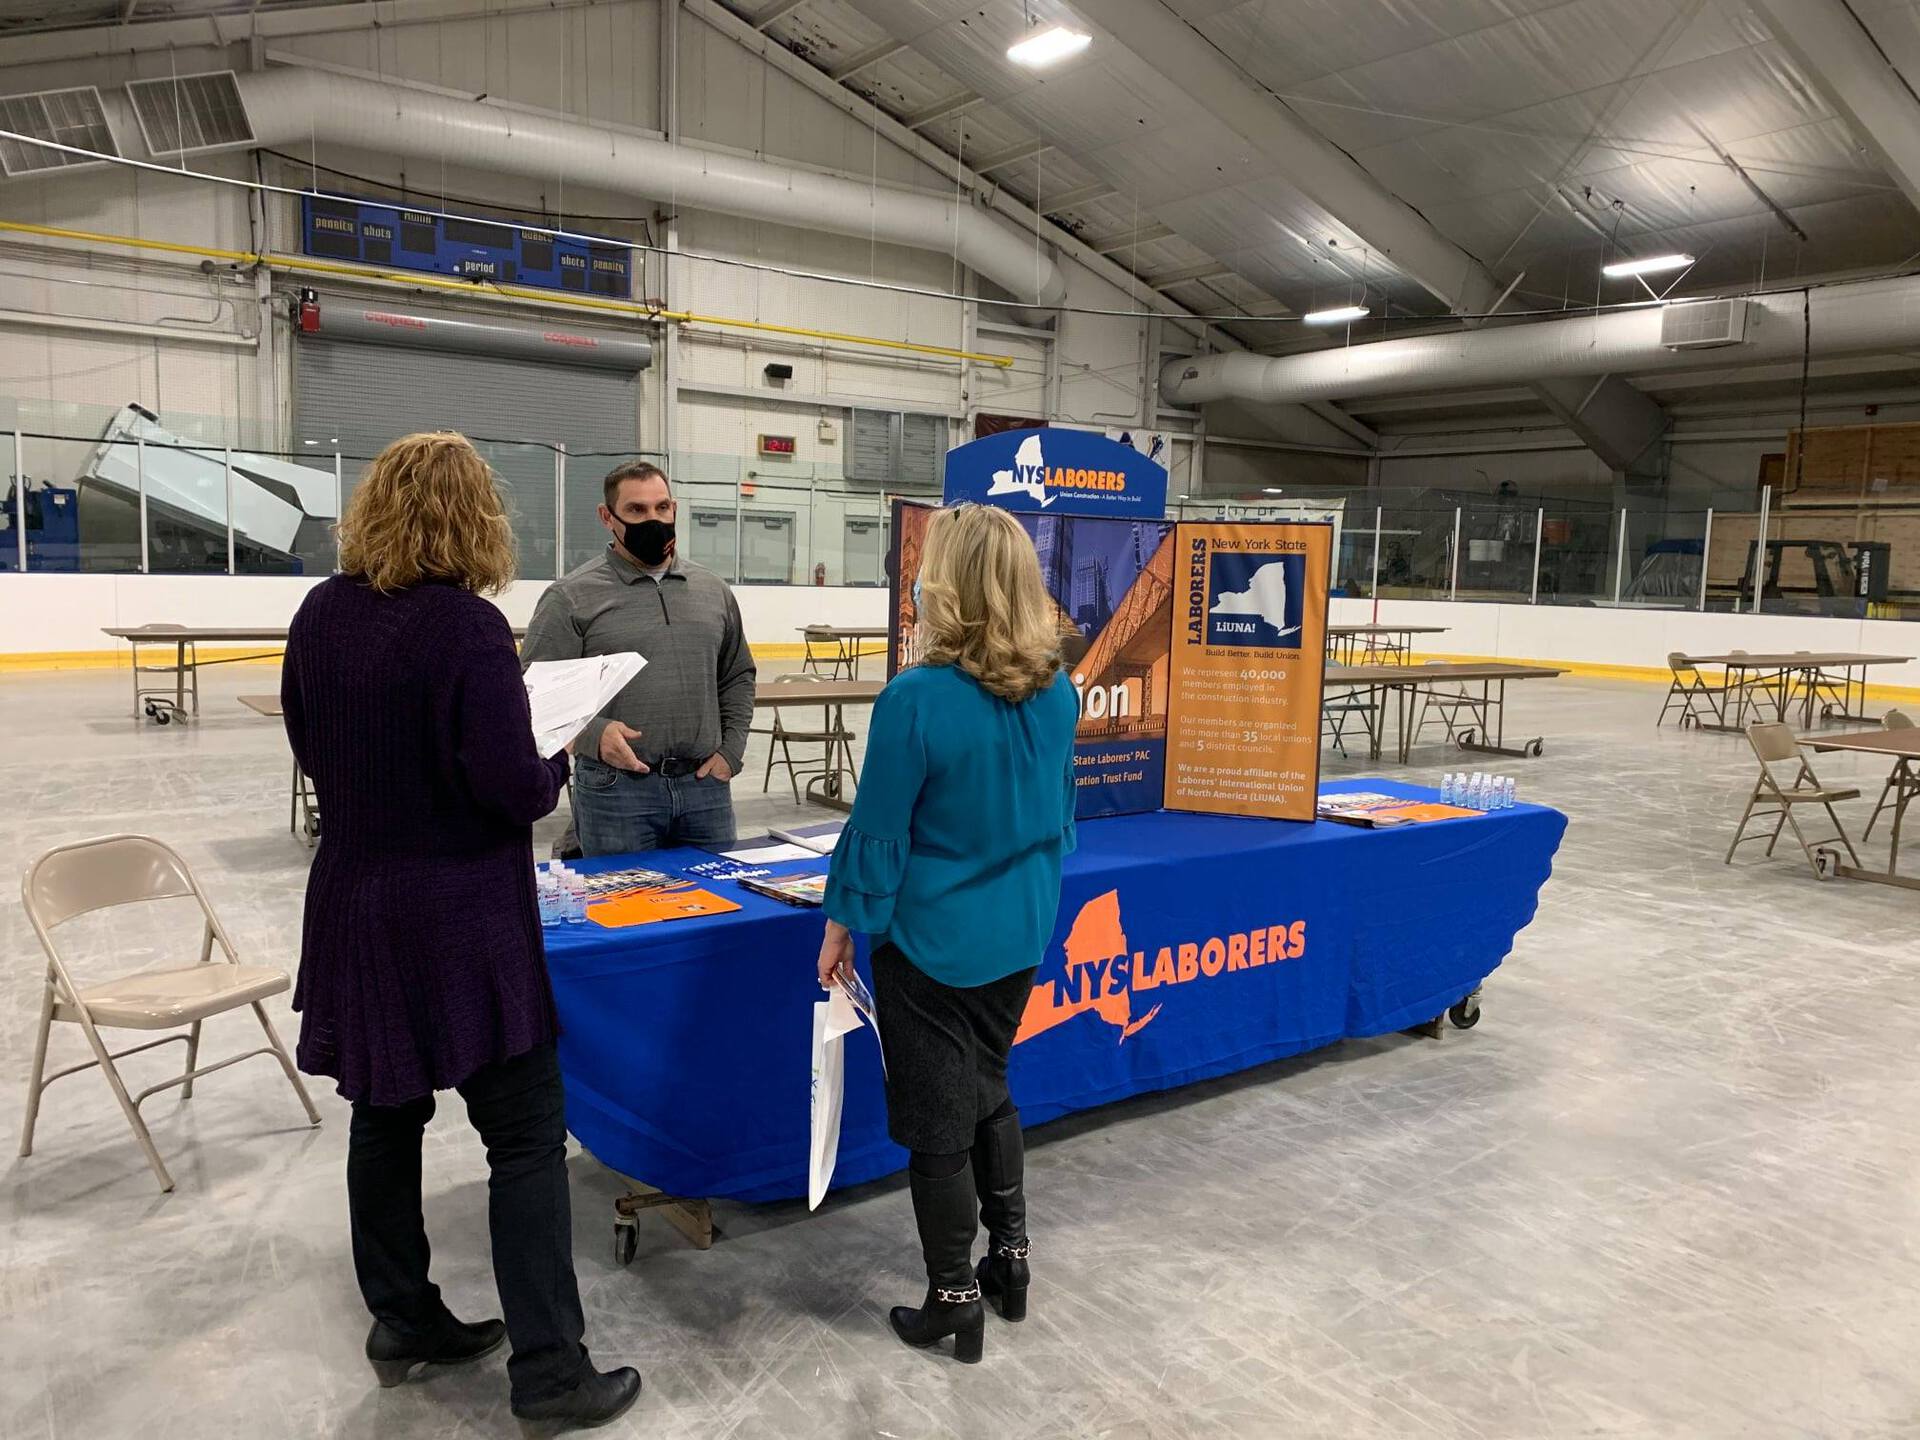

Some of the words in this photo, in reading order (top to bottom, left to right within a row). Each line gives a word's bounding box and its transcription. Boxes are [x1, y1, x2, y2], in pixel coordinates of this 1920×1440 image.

[315, 217, 354, 233] penalty
[363, 225, 392, 239] shots
[465, 260, 494, 274] period
[561, 254, 585, 268] shots
[592, 259, 624, 275] penalty
[1257, 506, 1277, 517] OF
[1211, 538, 1240, 549] New
[1245, 539, 1271, 550] York
[1275, 539, 1307, 551] State
[1862, 550, 1871, 569] Yale
[1187, 538, 1207, 646] LABORERS
[1206, 649, 1226, 658] Build
[1253, 651, 1274, 659] Build
[1183, 667, 1196, 676] We
[1198, 669, 1238, 680] represent
[1240, 669, 1287, 681] 40,000
[1182, 680, 1221, 690] members
[1222, 683, 1265, 693] employed
[1181, 692, 1195, 700] the
[1197, 693, 1250, 703] construction
[1251, 695, 1289, 706] industry.
[1180, 715, 1196, 724] Our
[1197, 717, 1238, 727] members
[1239, 721, 1253, 729] are
[1254, 721, 1297, 731] organized
[1180, 728, 1196, 736] into
[1198, 729, 1219, 738] more
[1221, 729, 1240, 739] than
[1242, 730, 1259, 743] 35
[1260, 732, 1281, 742] local
[1282, 734, 1313, 745] unions
[1179, 739, 1196, 749] and
[1196, 739, 1205, 752] 5
[1206, 741, 1237, 752] district
[1237, 743, 1276, 754] councils.
[1073, 755, 1096, 766] State
[1135, 750, 1151, 761] PAC
[1101, 773, 1121, 784] Trust
[1123, 770, 1143, 782] Fund
[1178, 763, 1192, 773] We
[1194, 765, 1208, 773] are
[1216, 767, 1242, 776] proud
[1243, 768, 1279, 779] affiliate
[1280, 771, 1288, 780] of
[1290, 771, 1306, 781] the
[1219, 778, 1276, 790] International
[1278, 782, 1305, 792] Union
[1176, 788, 1186, 797] of
[1187, 788, 1212, 798] North
[1213, 790, 1248, 801] America
